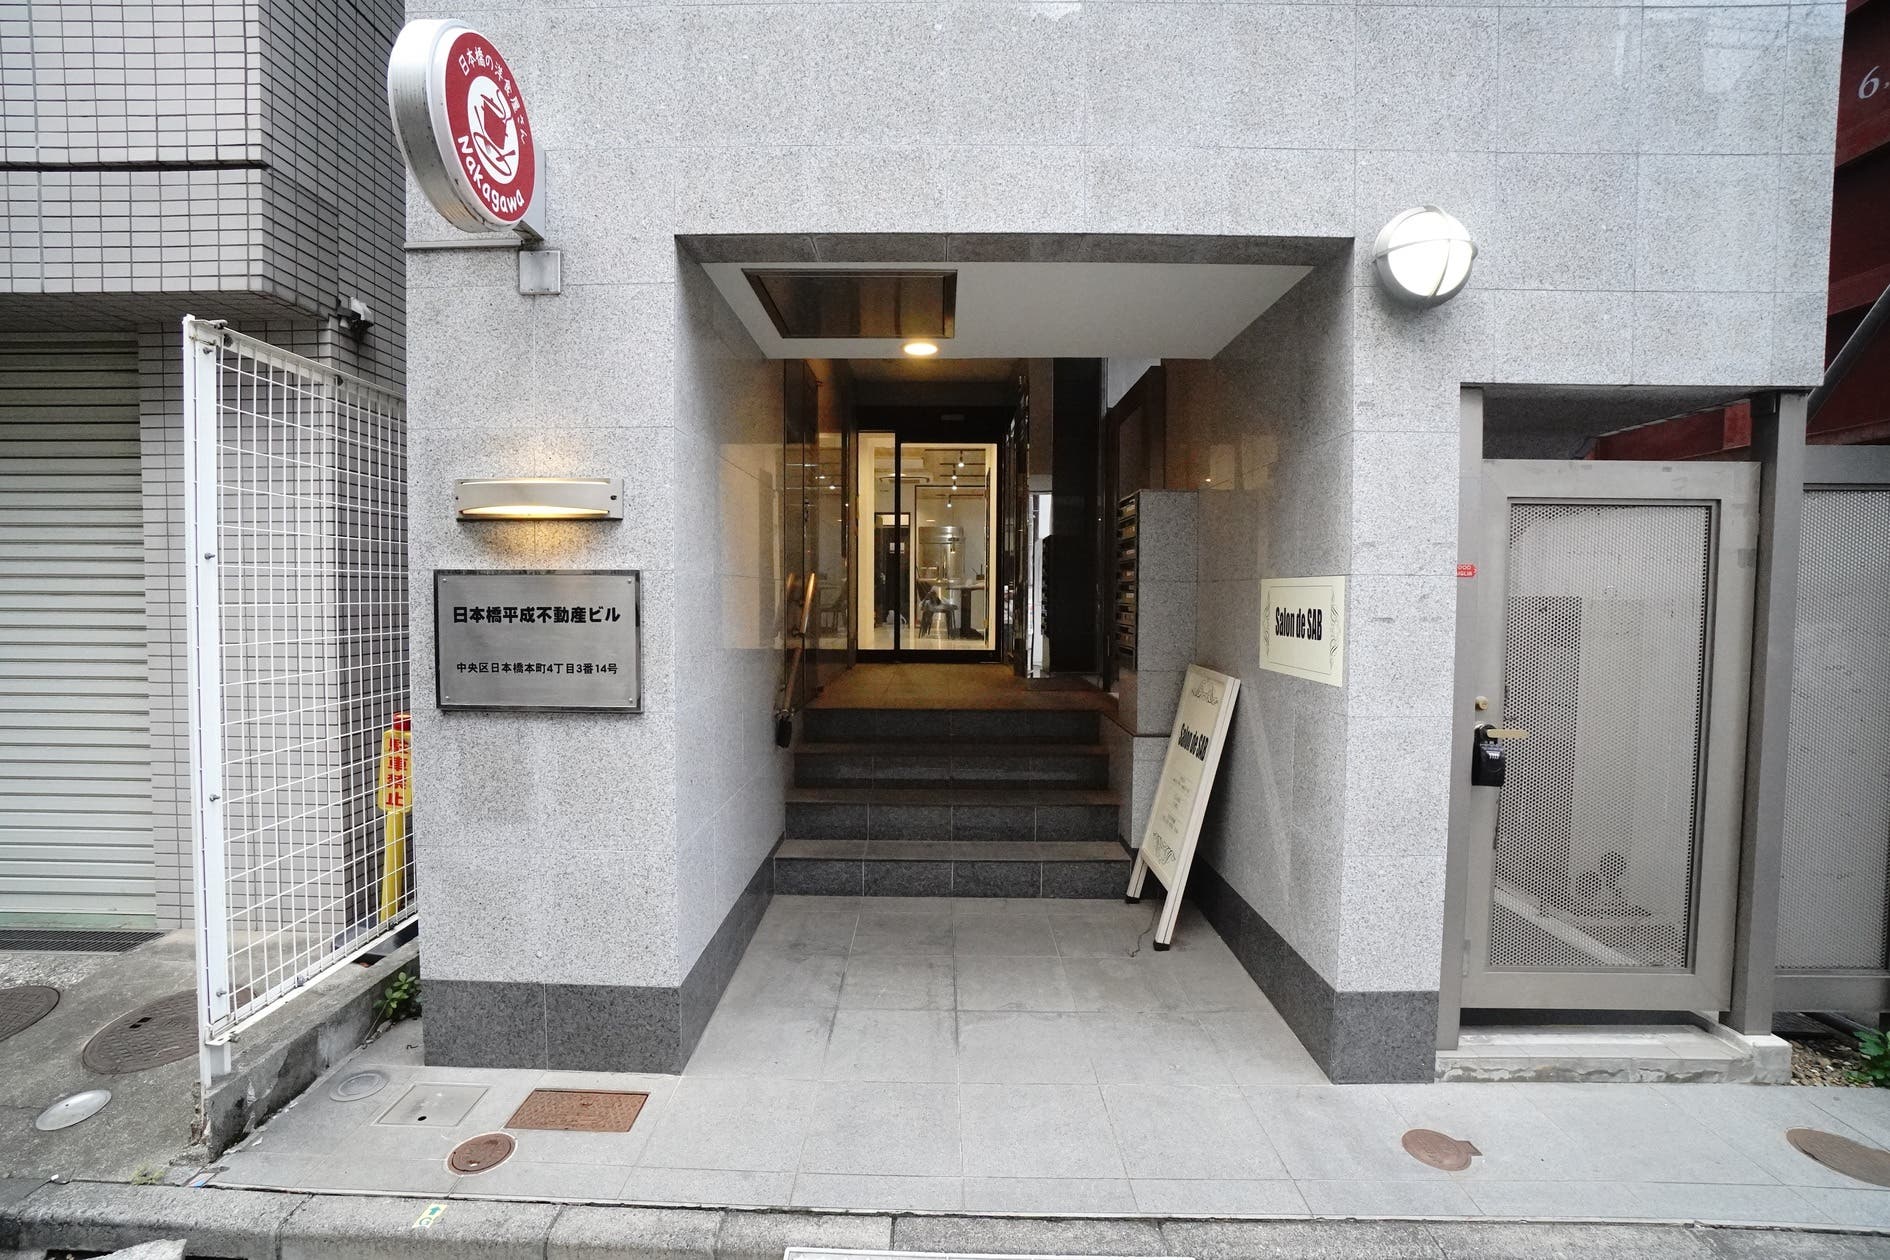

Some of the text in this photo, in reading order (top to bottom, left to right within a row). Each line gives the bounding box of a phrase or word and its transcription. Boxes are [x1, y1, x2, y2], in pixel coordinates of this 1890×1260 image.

[457, 135, 525, 214] Nakagawa
[453, 606, 621, 624] 日本橋平成不動産ビル
[1275, 606, 1323, 641] Salon de SAB
[456, 662, 618, 675] 中央区日本橋本町4丁目3番14号
[386, 738, 409, 806] 駐車禁止
